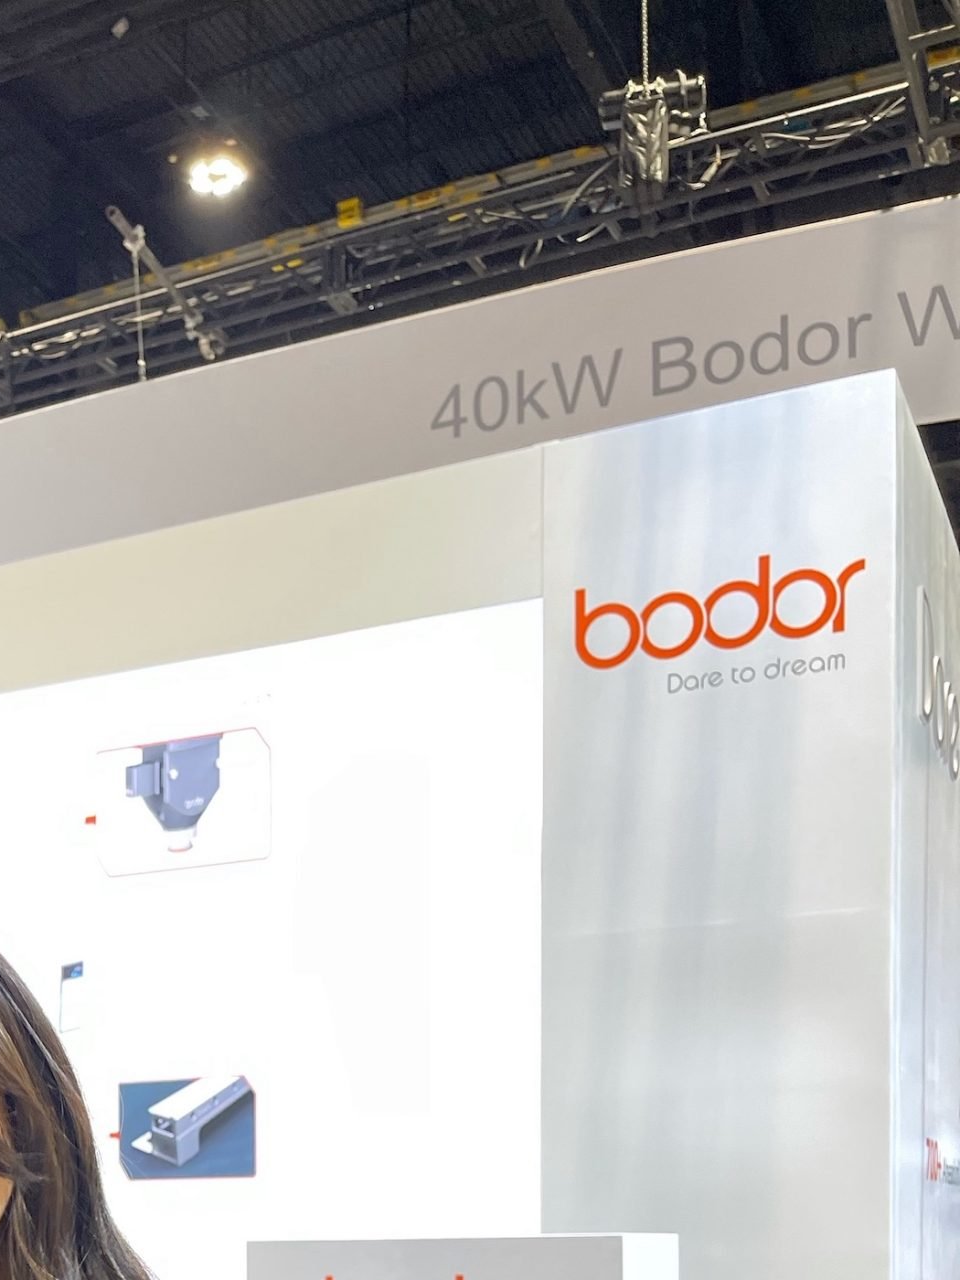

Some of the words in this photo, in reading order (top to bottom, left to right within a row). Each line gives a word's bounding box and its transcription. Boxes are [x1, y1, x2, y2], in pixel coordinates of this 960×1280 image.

[430, 348, 623, 438] 40kW
[650, 313, 872, 397] Bodor
[574, 554, 866, 670] bodor
[666, 668, 724, 694] Dare
[731, 664, 756, 685] to
[763, 652, 846, 680] dream
